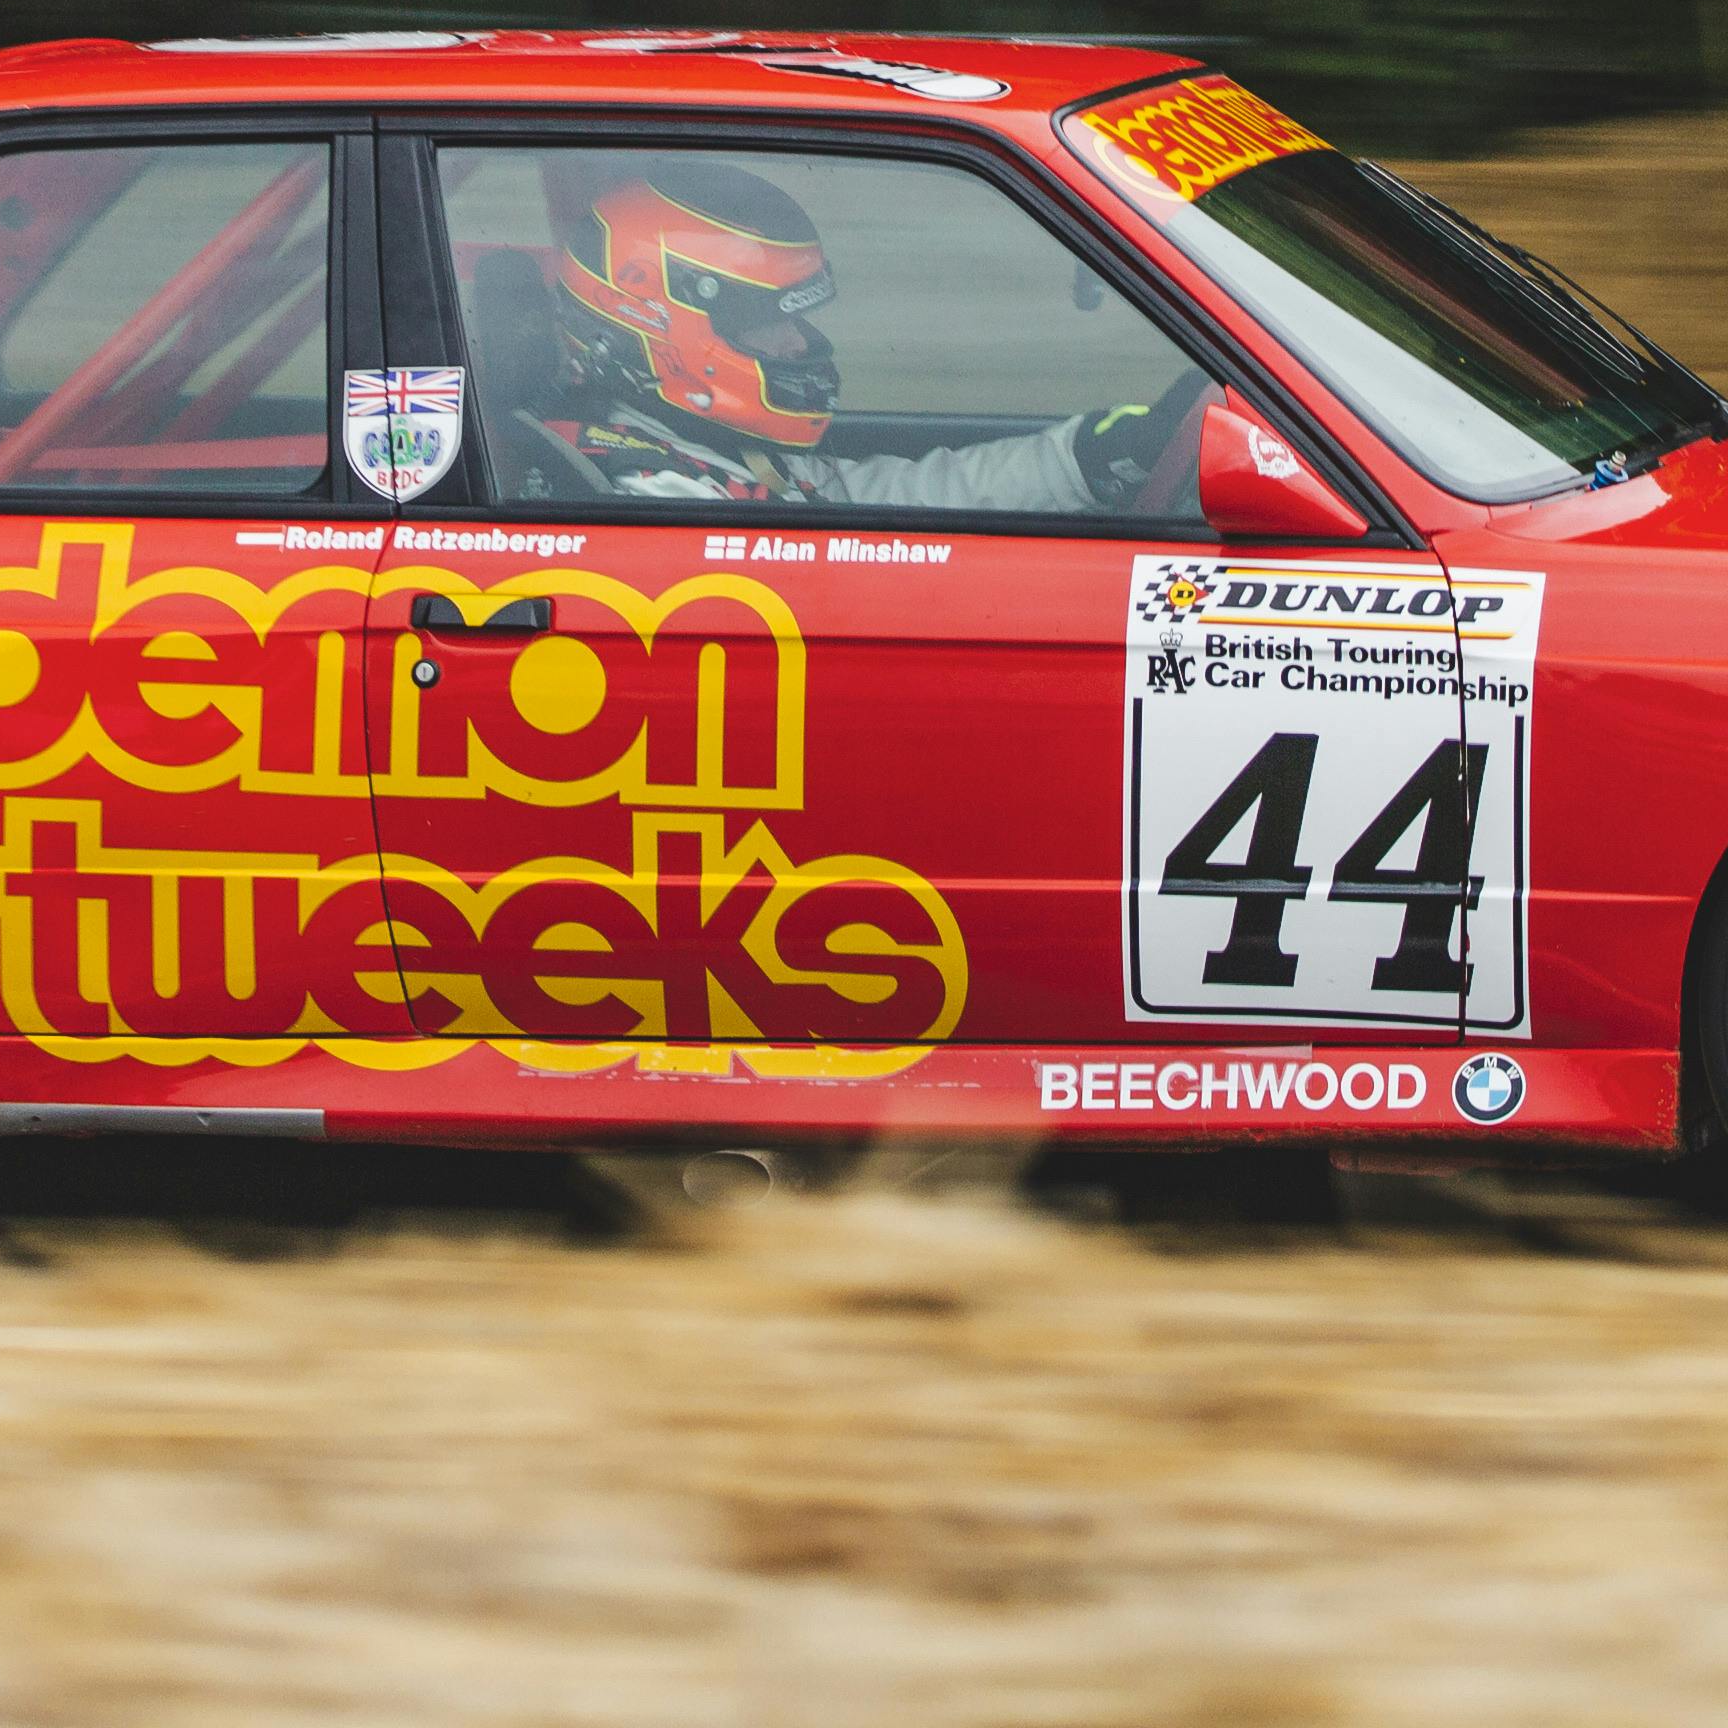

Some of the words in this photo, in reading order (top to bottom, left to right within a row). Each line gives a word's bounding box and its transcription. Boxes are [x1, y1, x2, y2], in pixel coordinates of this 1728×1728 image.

[376, 468, 424, 490] BRDC
[284, 525, 385, 551] Roland
[393, 525, 588, 558] Ratzenberger
[750, 536, 817, 562] Alan
[826, 537, 952, 564] Minshaw
[1216, 581, 1505, 623] DUNLOP
[1146, 647, 1196, 695] RAC
[1204, 633, 1313, 662] British
[1327, 638, 1457, 672] Touring
[1204, 661, 1266, 689] Car
[1280, 665, 1529, 708] Championship
[1157, 731, 1491, 997] 44
[1039, 1061, 1427, 1111] BEECHWOOD
[1461, 1056, 1520, 1080] BMW
